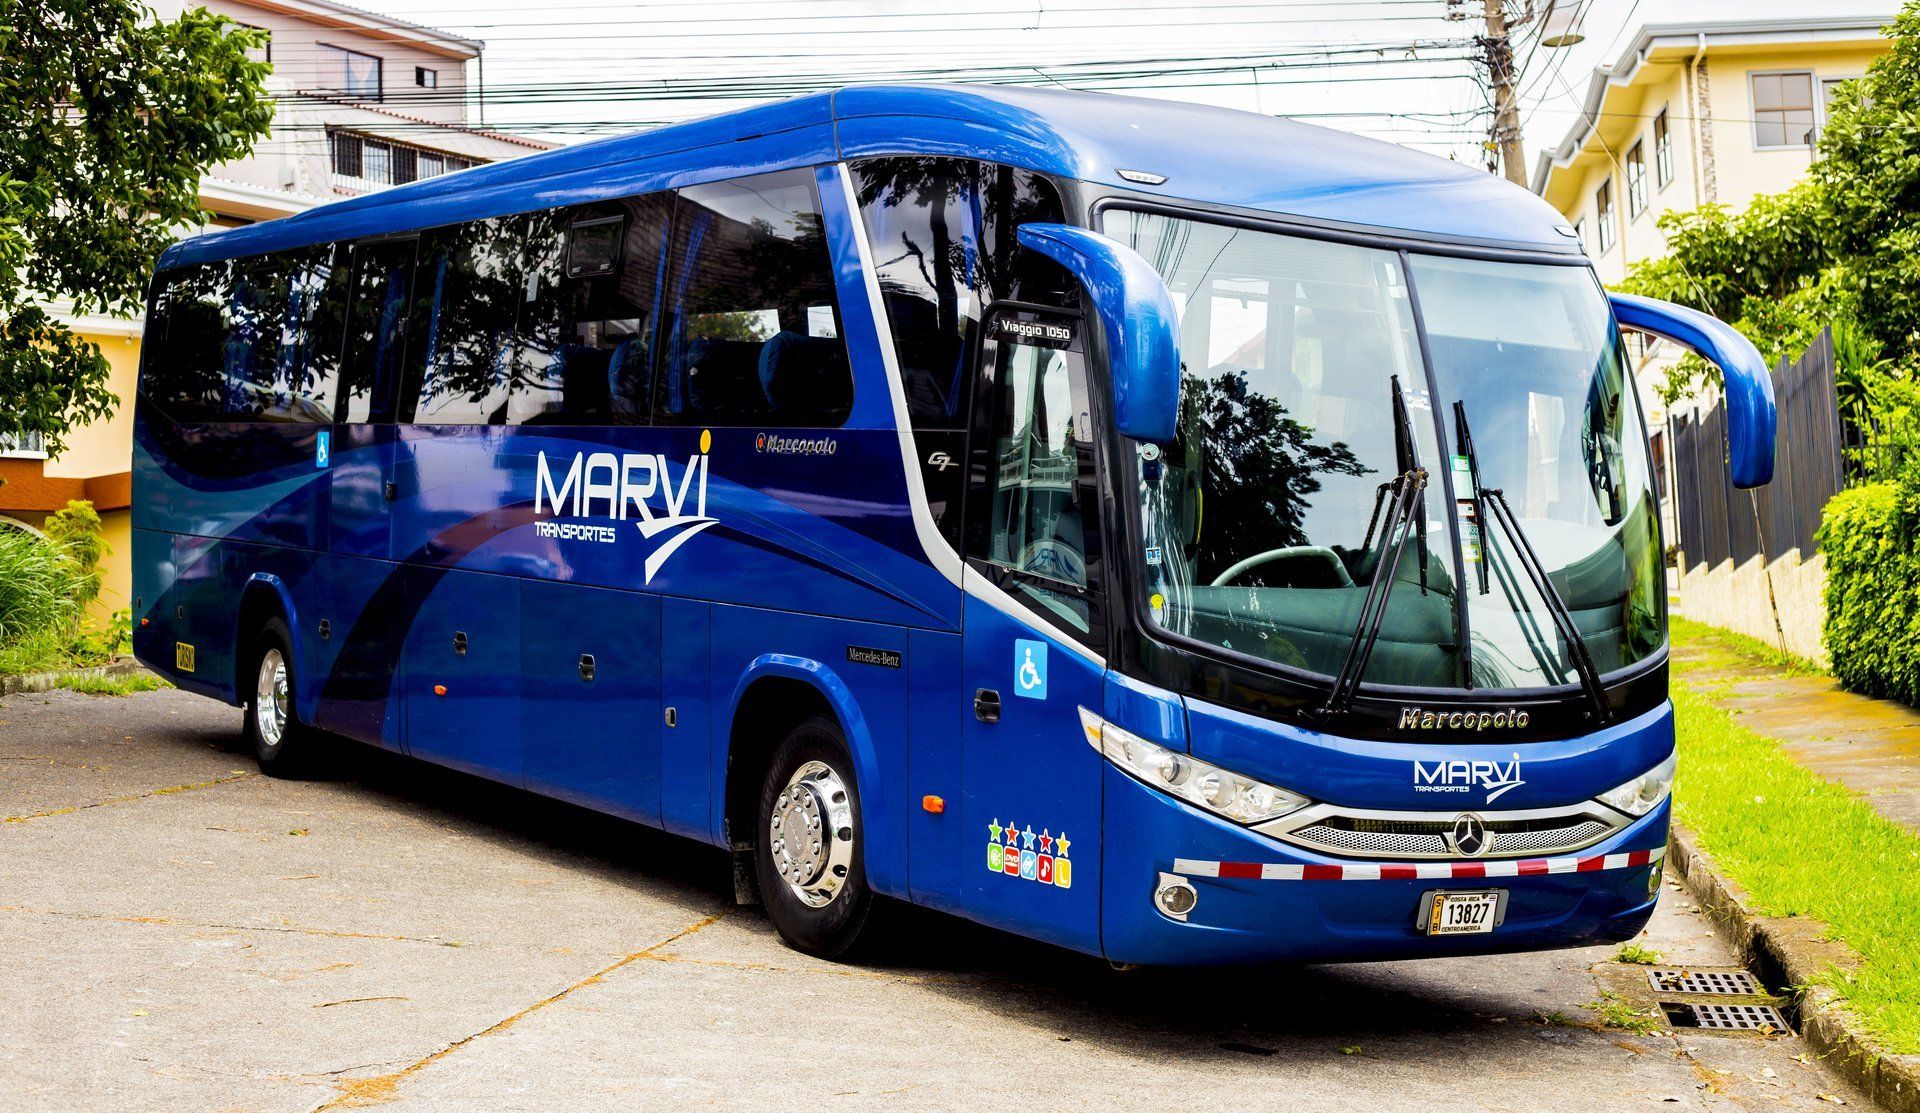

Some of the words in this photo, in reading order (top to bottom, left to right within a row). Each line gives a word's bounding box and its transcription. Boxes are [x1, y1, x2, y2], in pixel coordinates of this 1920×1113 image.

[1002, 320, 1042, 337] Viaggio
[1046, 326, 1070, 340] 1050
[766, 434, 837, 456] Marcopolo
[534, 521, 616, 543] TRANSPORTES
[849, 647, 899, 667] Mercedes-Benz
[1398, 706, 1530, 732] Marcopolo
[1414, 785, 1470, 793] TRANSPORTES
[1448, 903, 1490, 925] 13827
[1441, 925, 1481, 933] CENTROAMERICA
